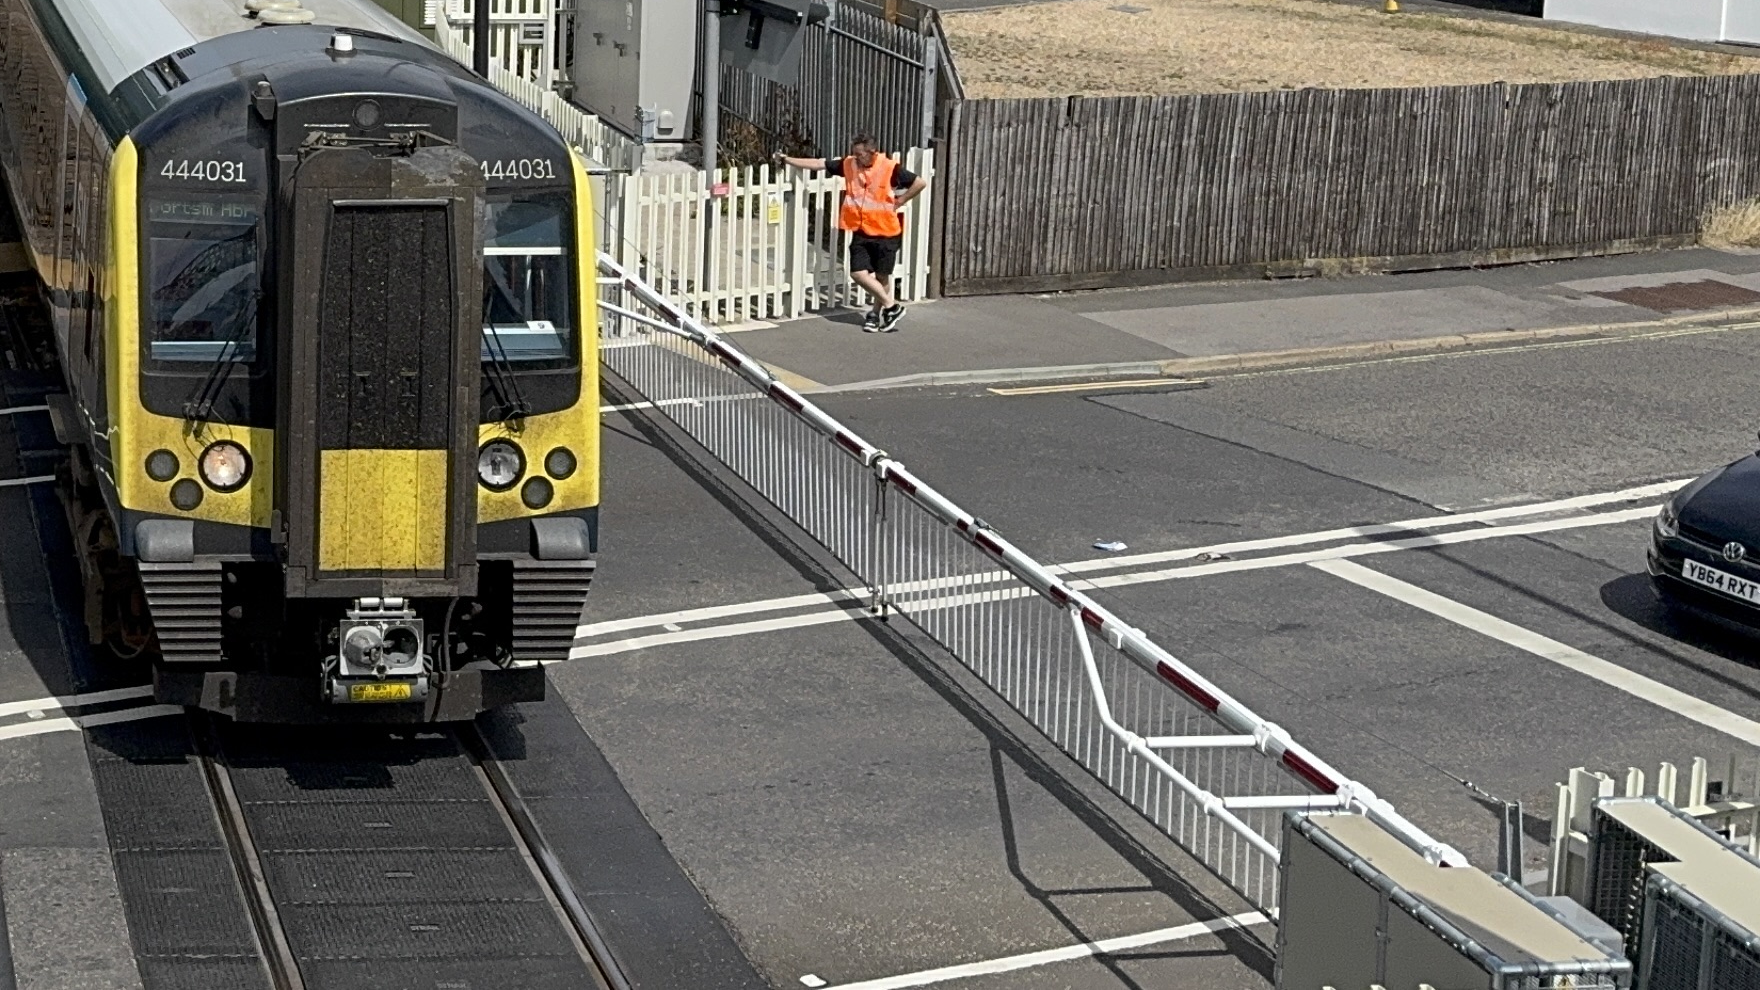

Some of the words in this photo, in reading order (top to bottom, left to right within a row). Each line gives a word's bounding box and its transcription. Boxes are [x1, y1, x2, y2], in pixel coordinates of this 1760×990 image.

[161, 159, 246, 182] 444031
[480, 158, 556, 181] 444031
[149, 203, 213, 216] ortsm
[1690, 562, 1724, 588] YB64
[1727, 577, 1758, 599] RXT
